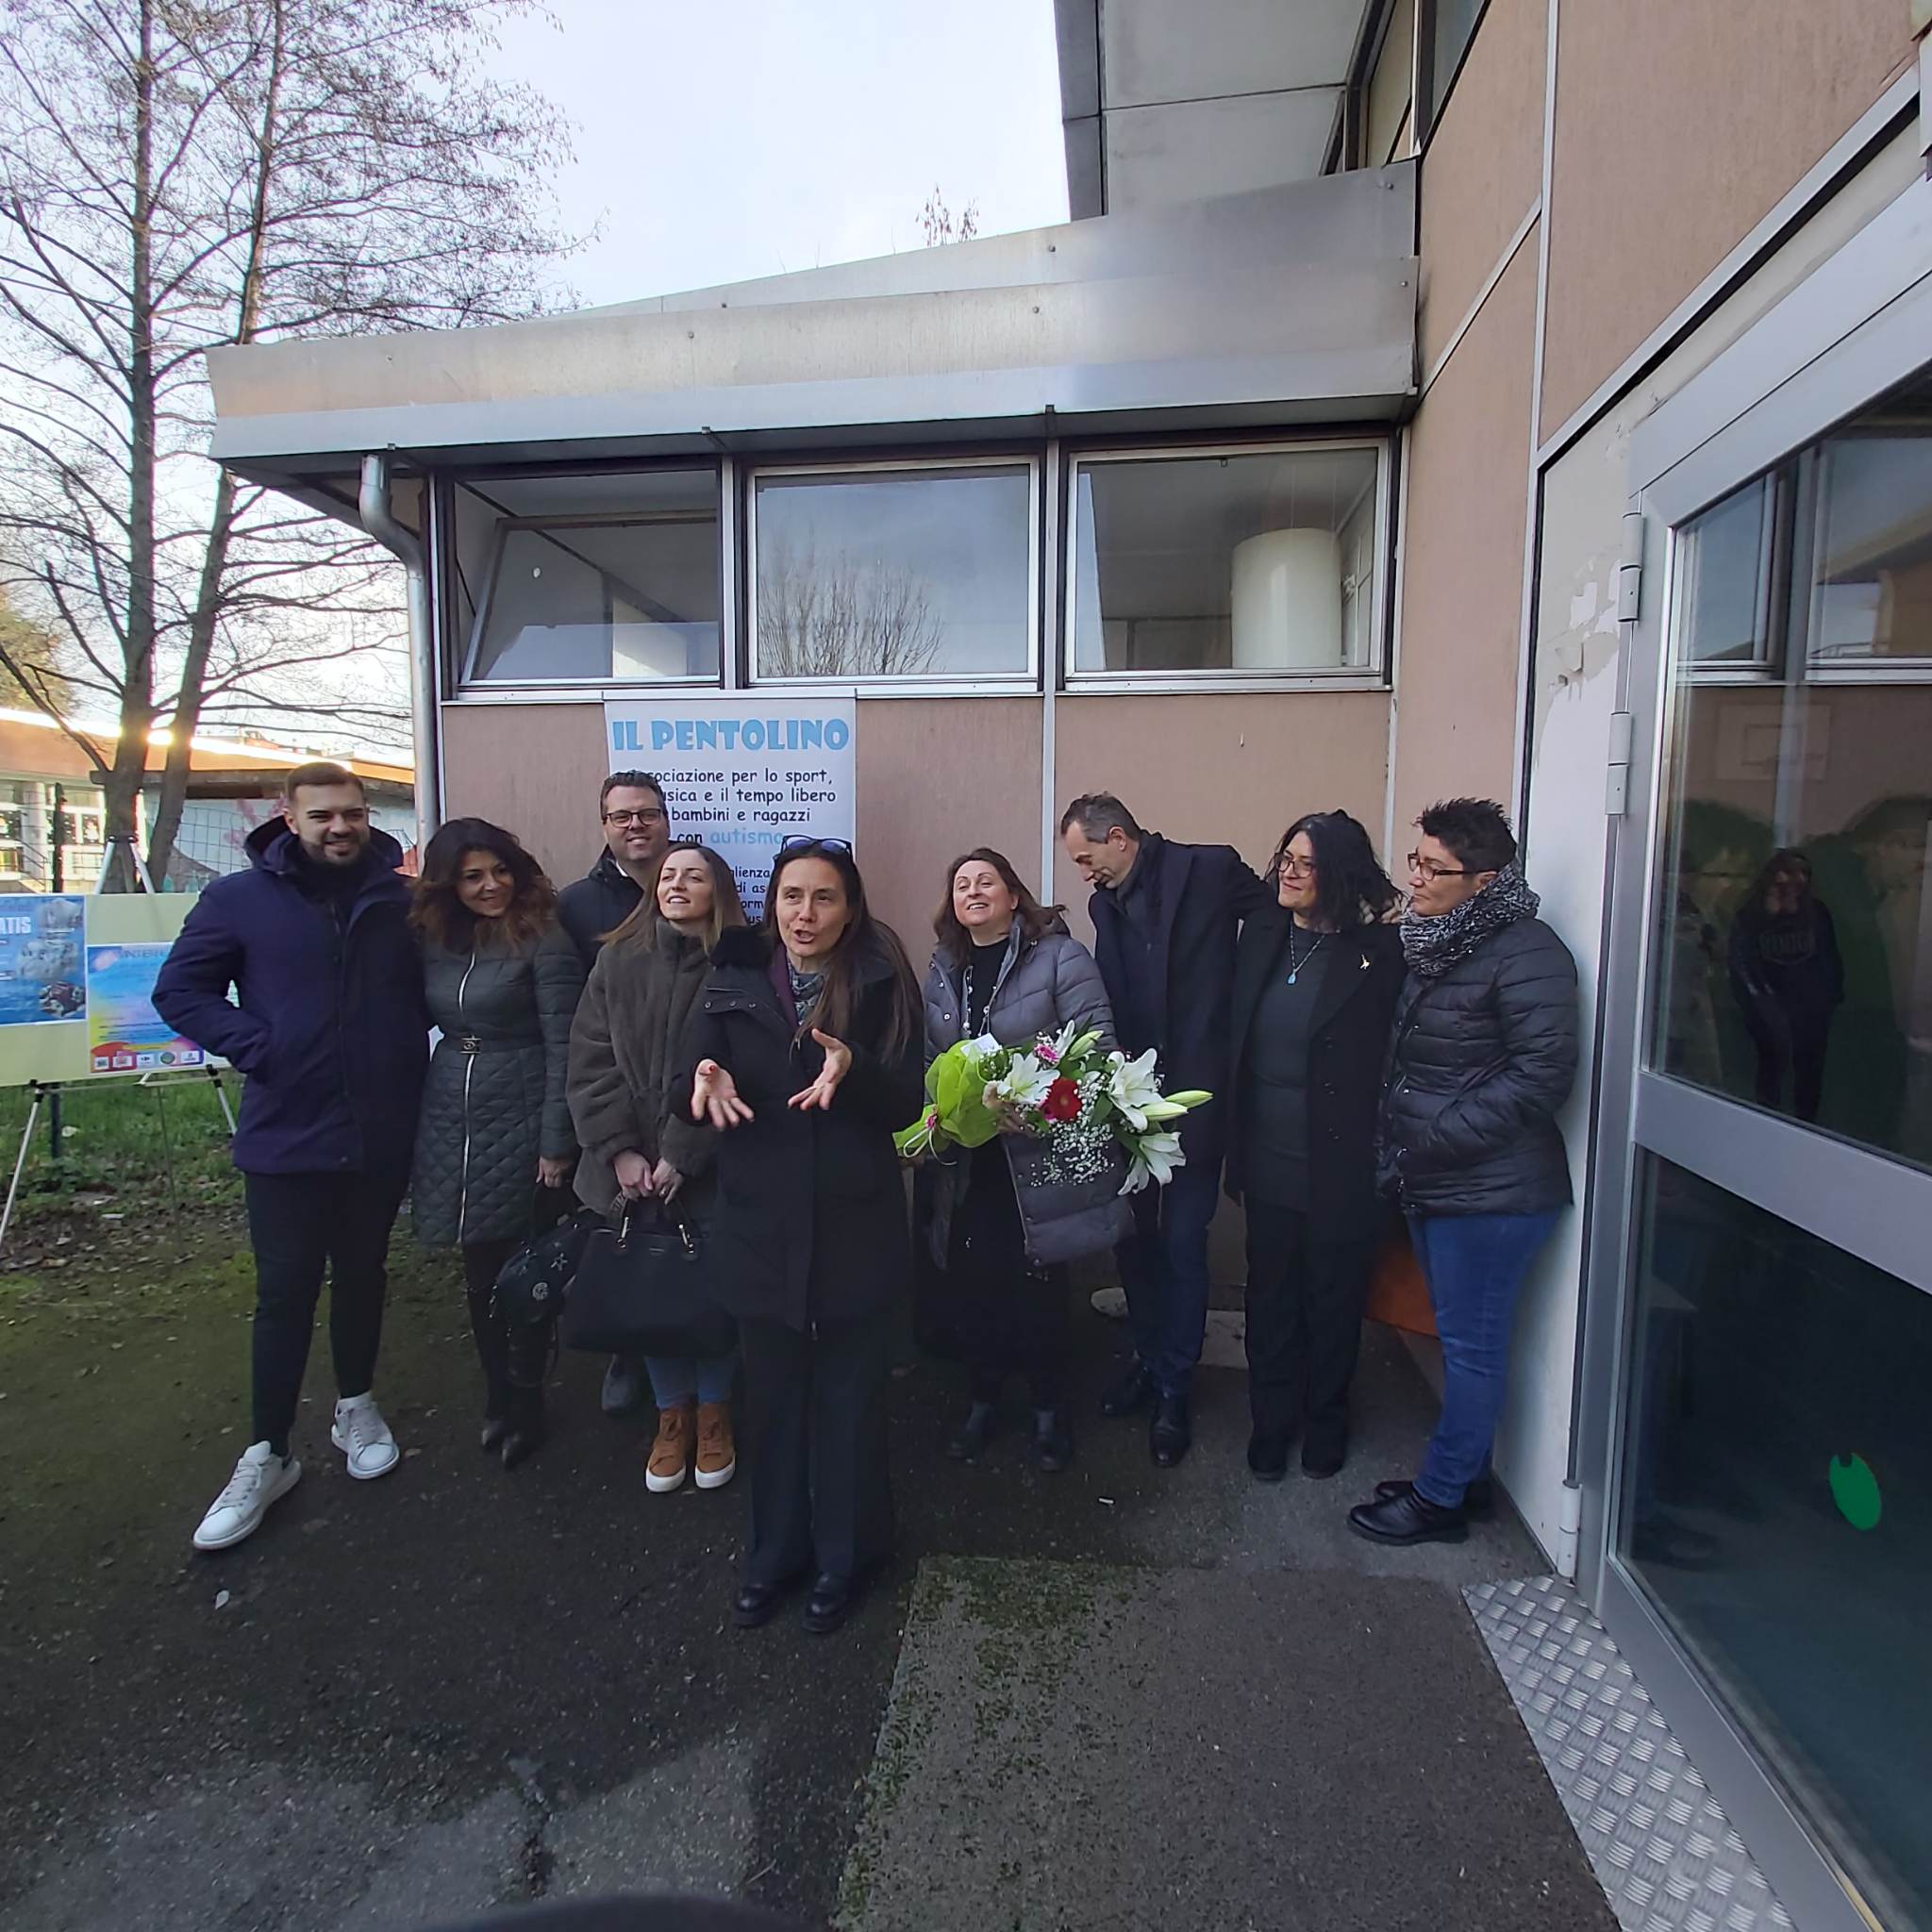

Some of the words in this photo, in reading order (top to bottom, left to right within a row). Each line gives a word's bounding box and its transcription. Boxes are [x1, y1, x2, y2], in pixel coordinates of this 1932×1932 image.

[612, 720, 643, 751] IL
[651, 718, 850, 751] PENTOLINO
[732, 770, 758, 787] per
[765, 767, 778, 783] lo
[786, 769, 833, 787] sport,
[704, 791, 713, 802] e
[721, 787, 729, 802] il
[737, 789, 784, 806] tempo
[791, 787, 837, 803] libero
[671, 807, 730, 823] bambini
[737, 810, 746, 822] e
[753, 807, 811, 825] ragazzi
[676, 833, 703, 844] con
[752, 885, 766, 894] as
[0, 916, 31, 935] ATIS
